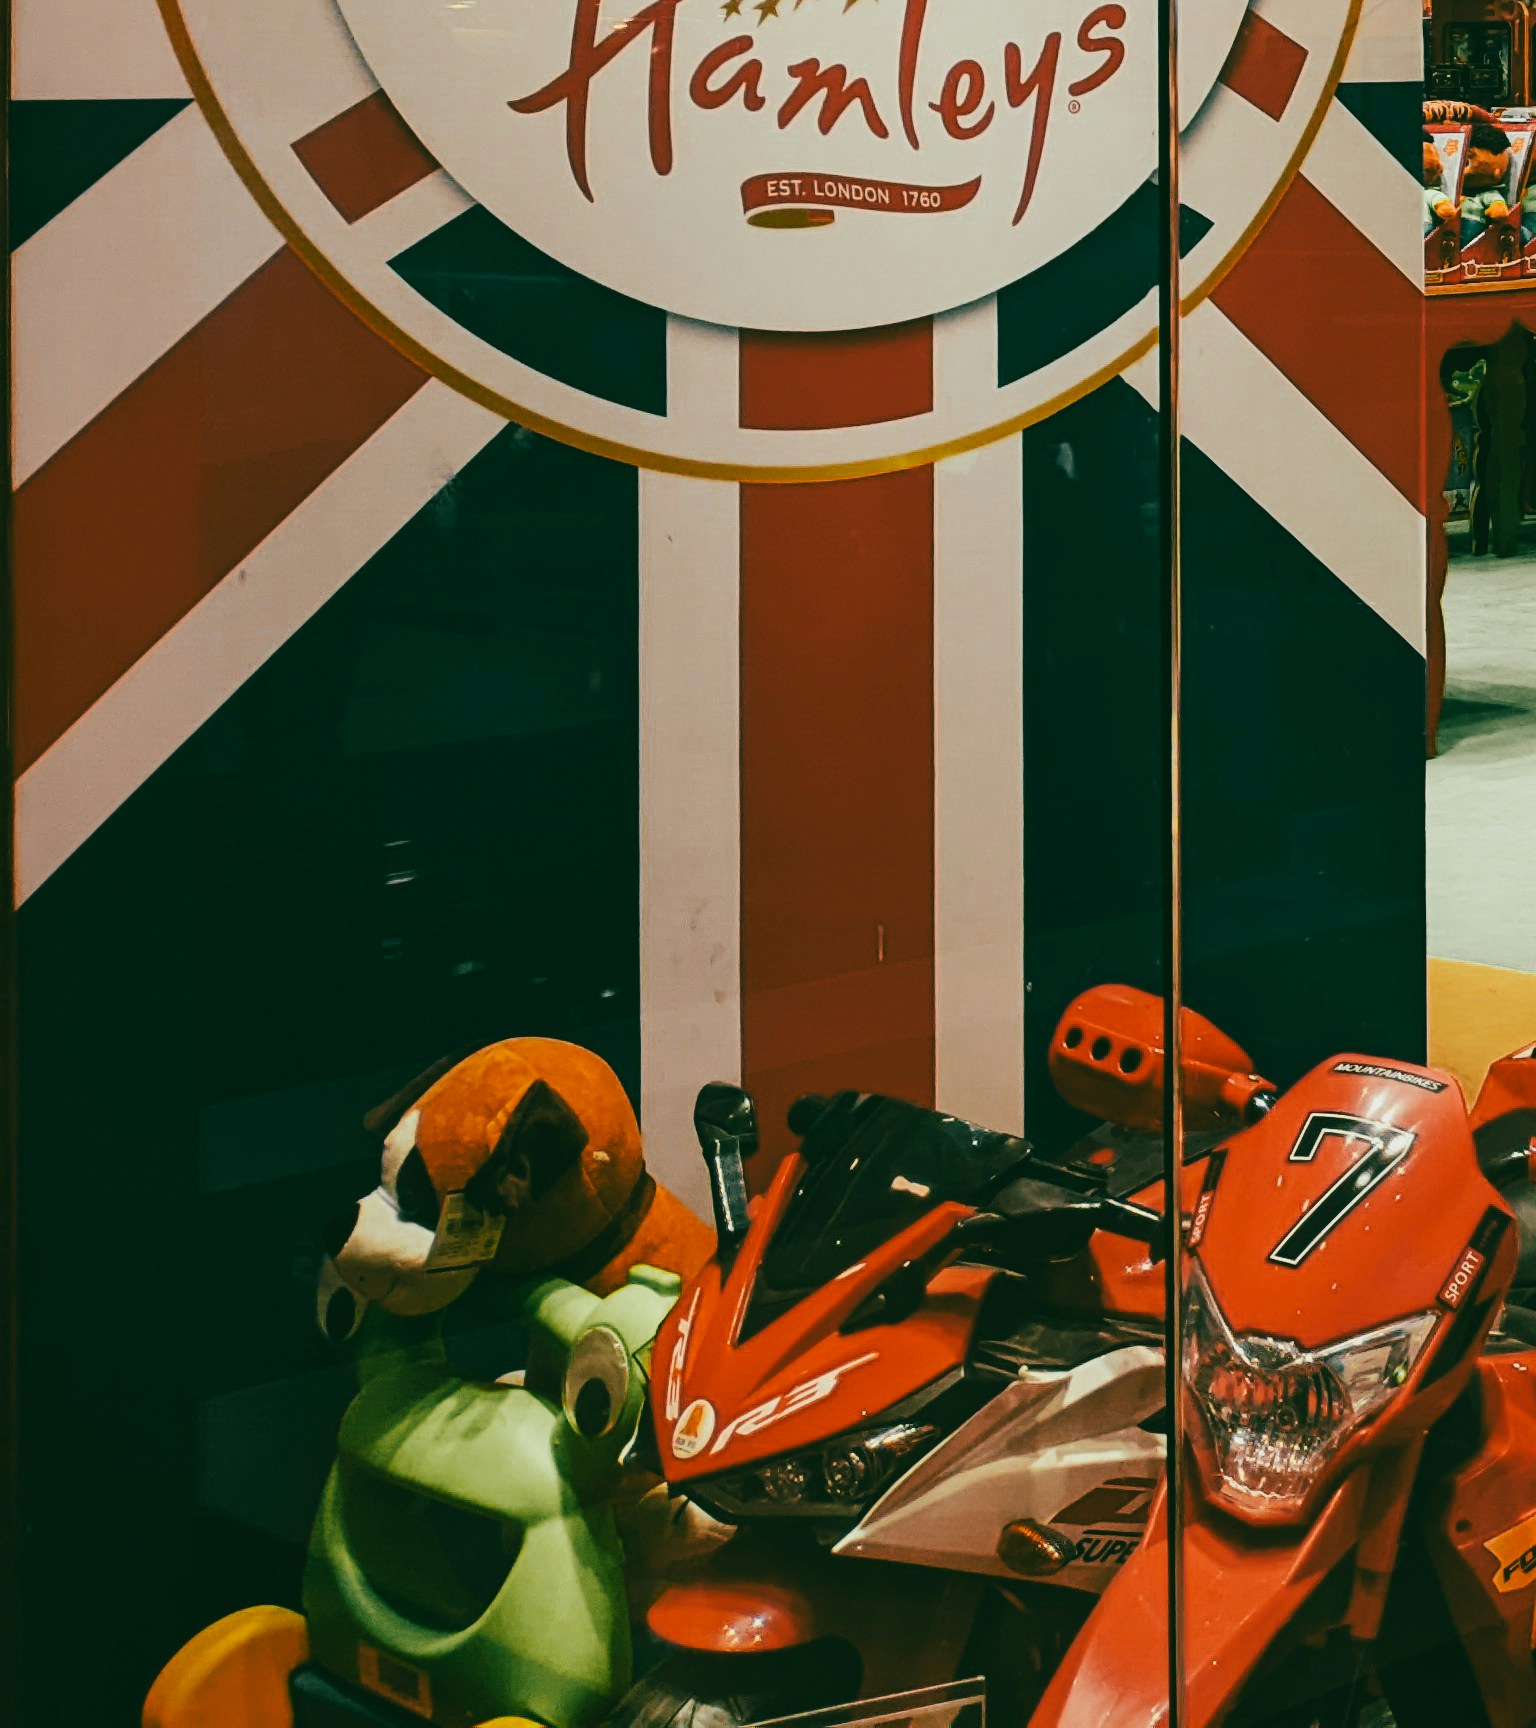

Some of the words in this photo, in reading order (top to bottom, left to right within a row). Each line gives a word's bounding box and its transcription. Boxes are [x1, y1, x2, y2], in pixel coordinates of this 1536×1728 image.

[766, 179, 806, 197] EST.
[813, 180, 890, 204] LONDON
[902, 190, 941, 208] 1760
[1333, 1063, 1440, 1091] MOUNTAINBIKES
[1266, 1110, 1419, 1268] 7
[1189, 1193, 1211, 1246] SPORT
[1444, 1249, 1481, 1303] SPORT
